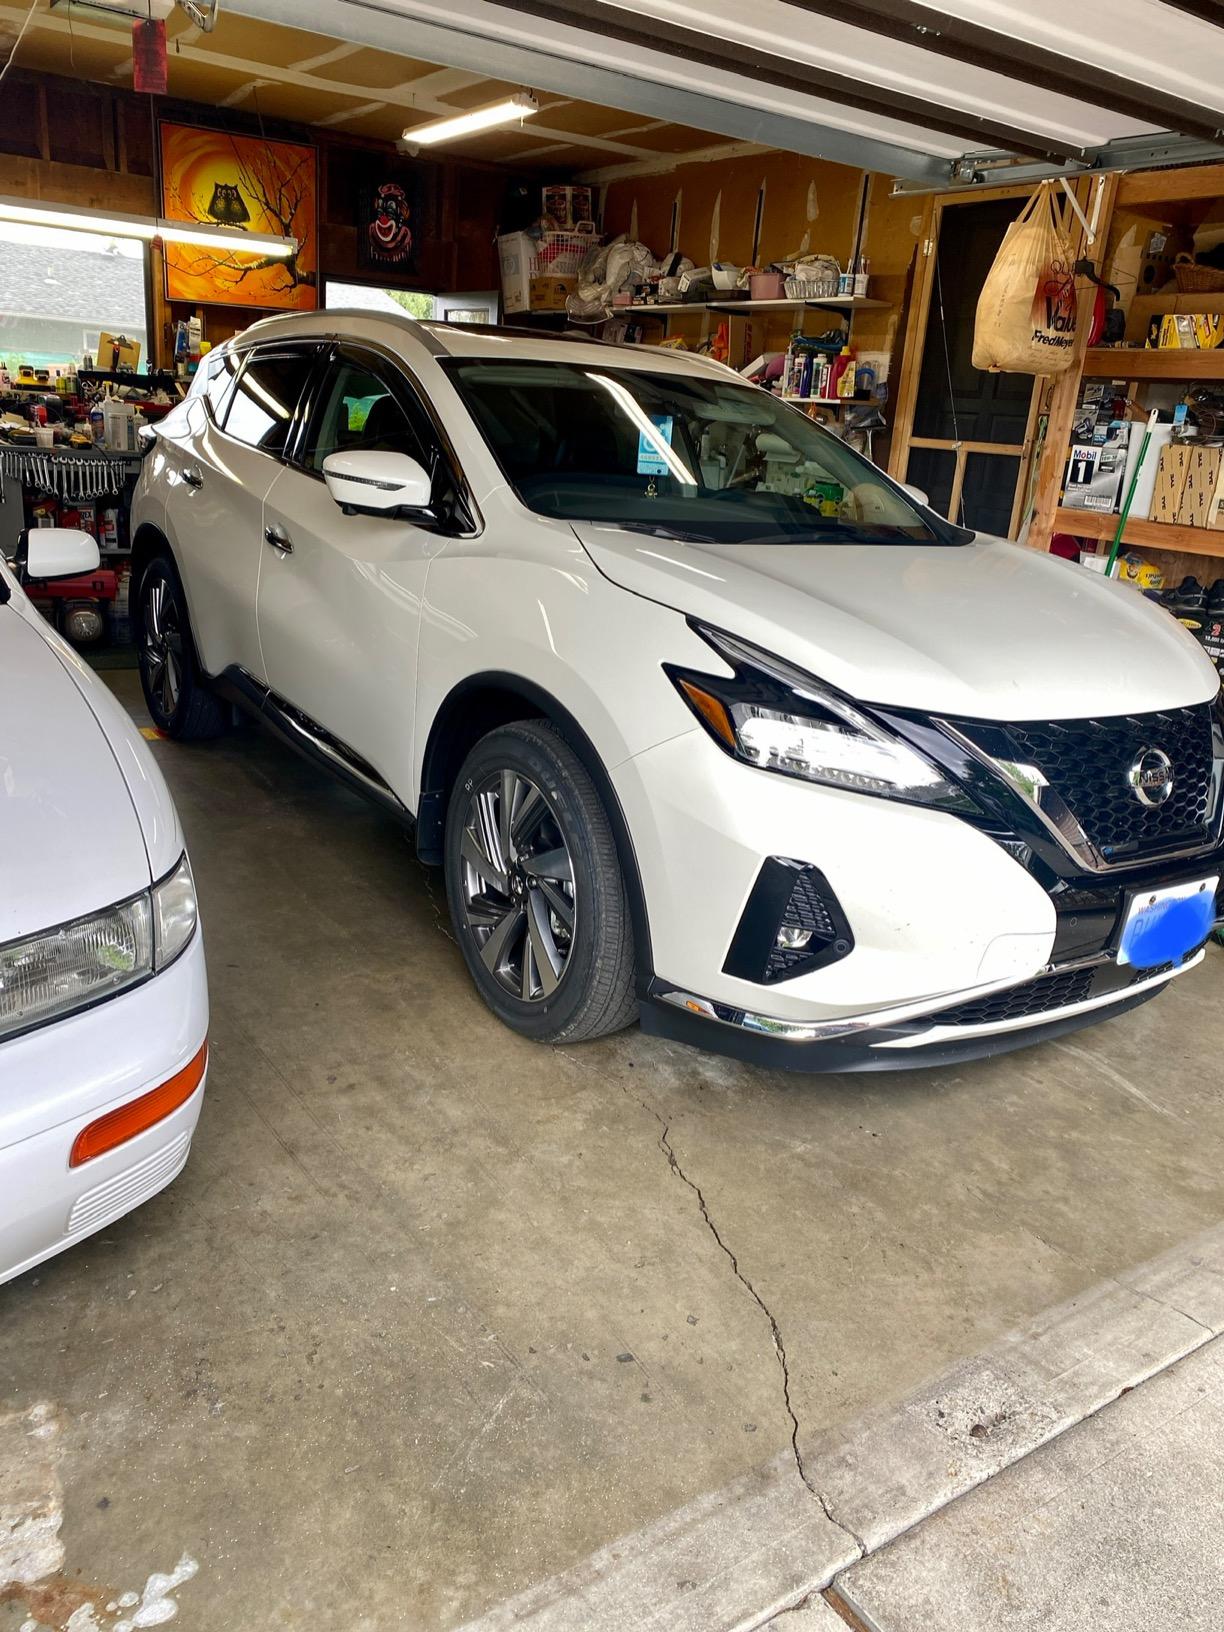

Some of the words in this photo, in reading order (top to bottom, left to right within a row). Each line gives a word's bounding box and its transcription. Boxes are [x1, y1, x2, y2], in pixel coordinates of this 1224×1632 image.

[1073, 450, 1097, 460] Mobil
[1077, 460, 1088, 483] 1
[1139, 767, 1174, 787] NISS
